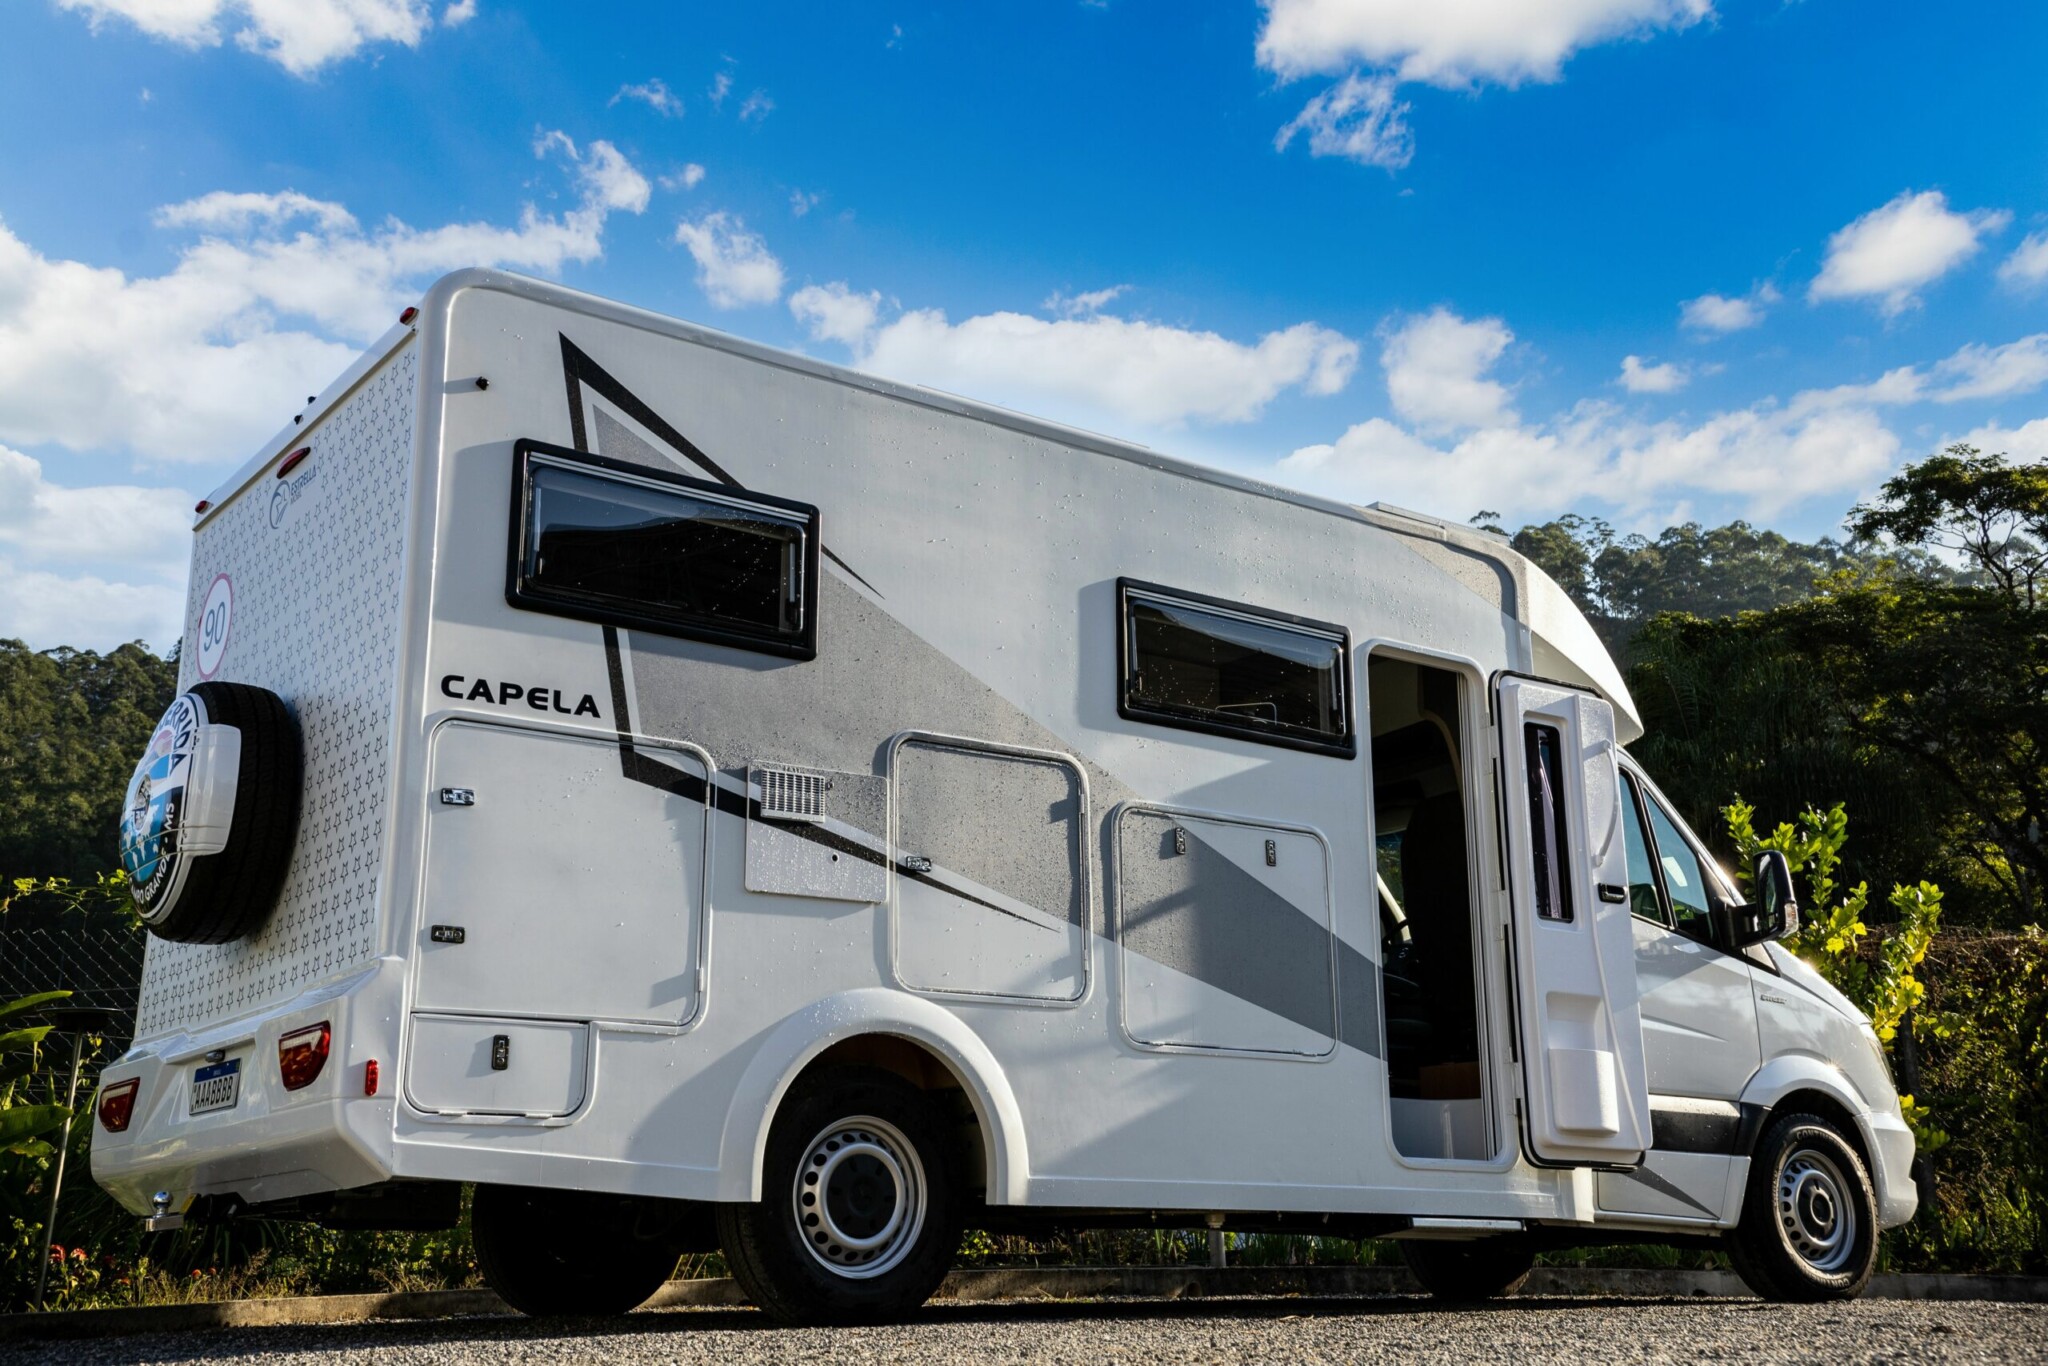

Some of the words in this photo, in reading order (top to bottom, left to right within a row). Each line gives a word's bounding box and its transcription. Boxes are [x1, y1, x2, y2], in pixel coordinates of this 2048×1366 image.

[291, 464, 317, 496] ESTRELLA
[204, 601, 225, 652] 90
[440, 674, 601, 719] CAPELA
[164, 803, 175, 830] MS
